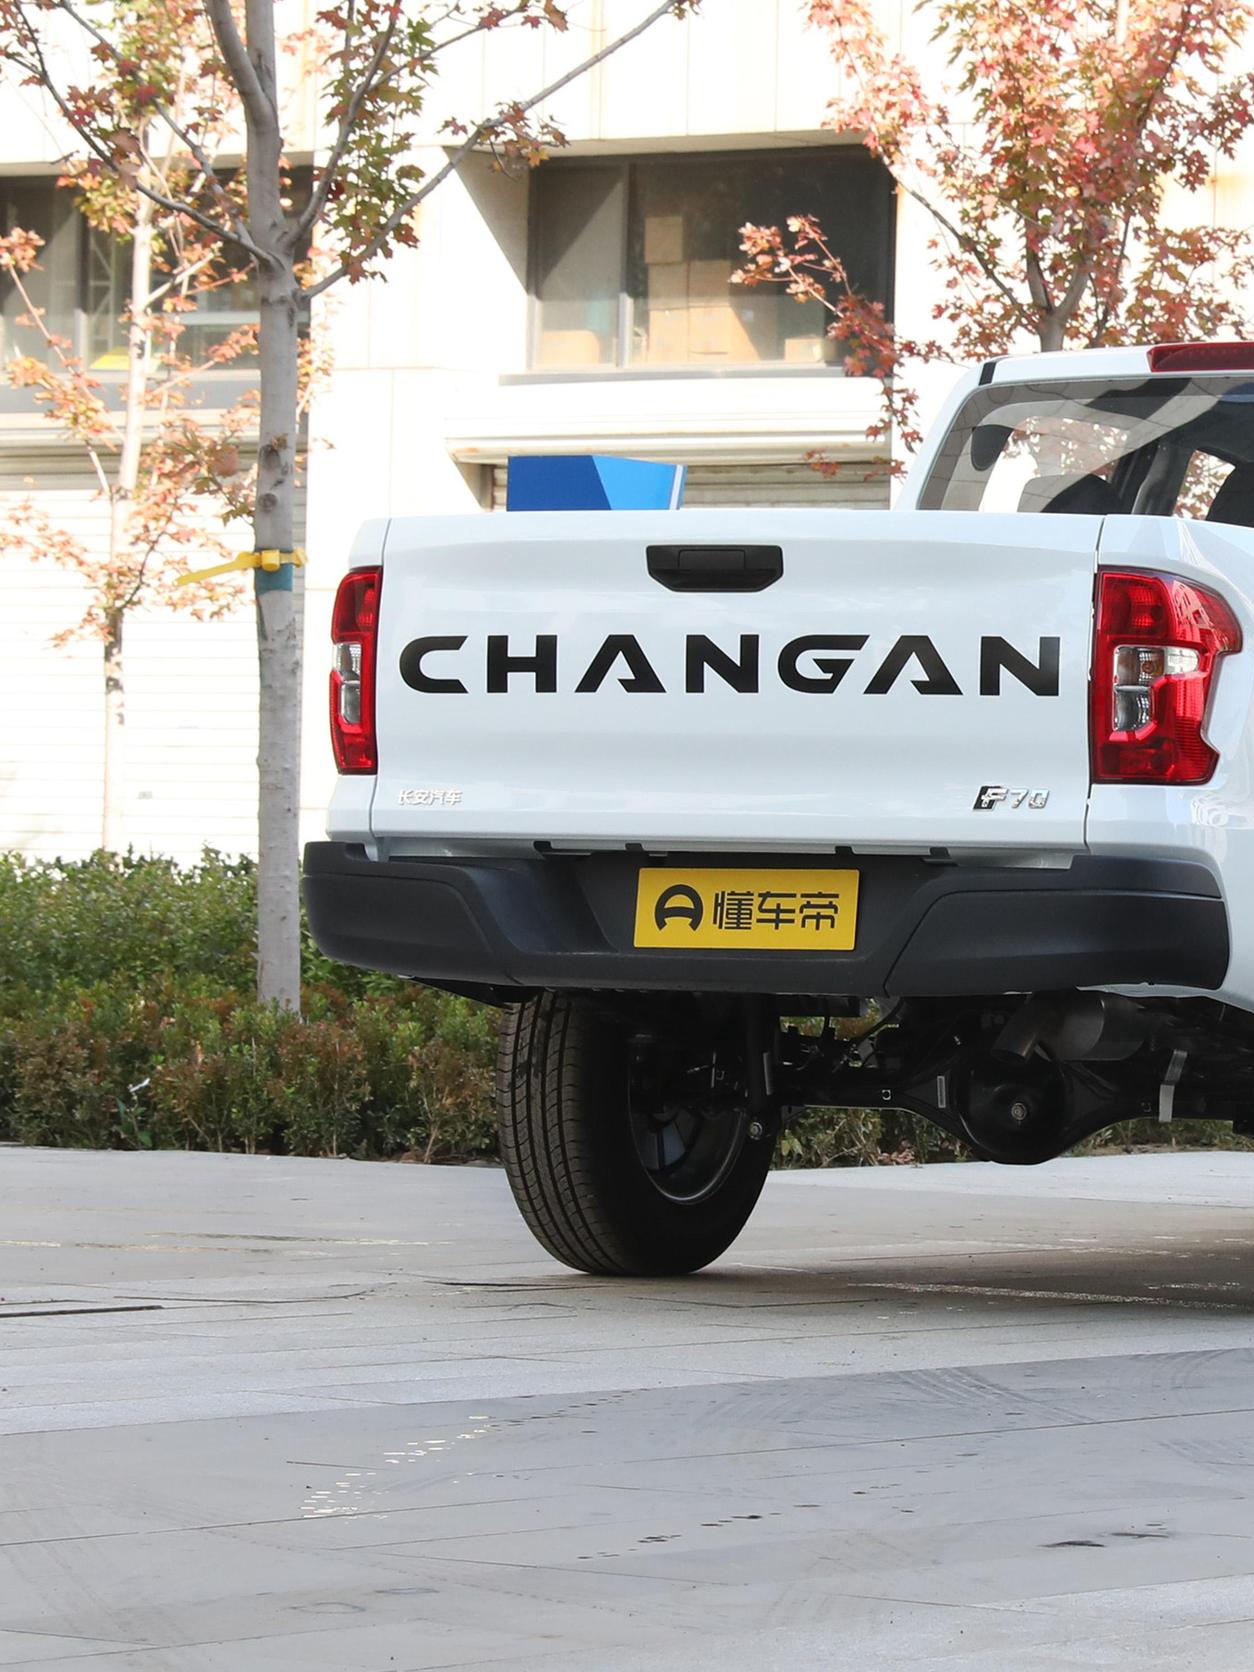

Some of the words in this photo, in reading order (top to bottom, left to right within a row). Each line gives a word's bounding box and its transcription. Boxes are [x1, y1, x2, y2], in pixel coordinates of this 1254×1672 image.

[399, 633, 1060, 696] CHANGAN
[713, 890, 840, 931] 懂车帝
